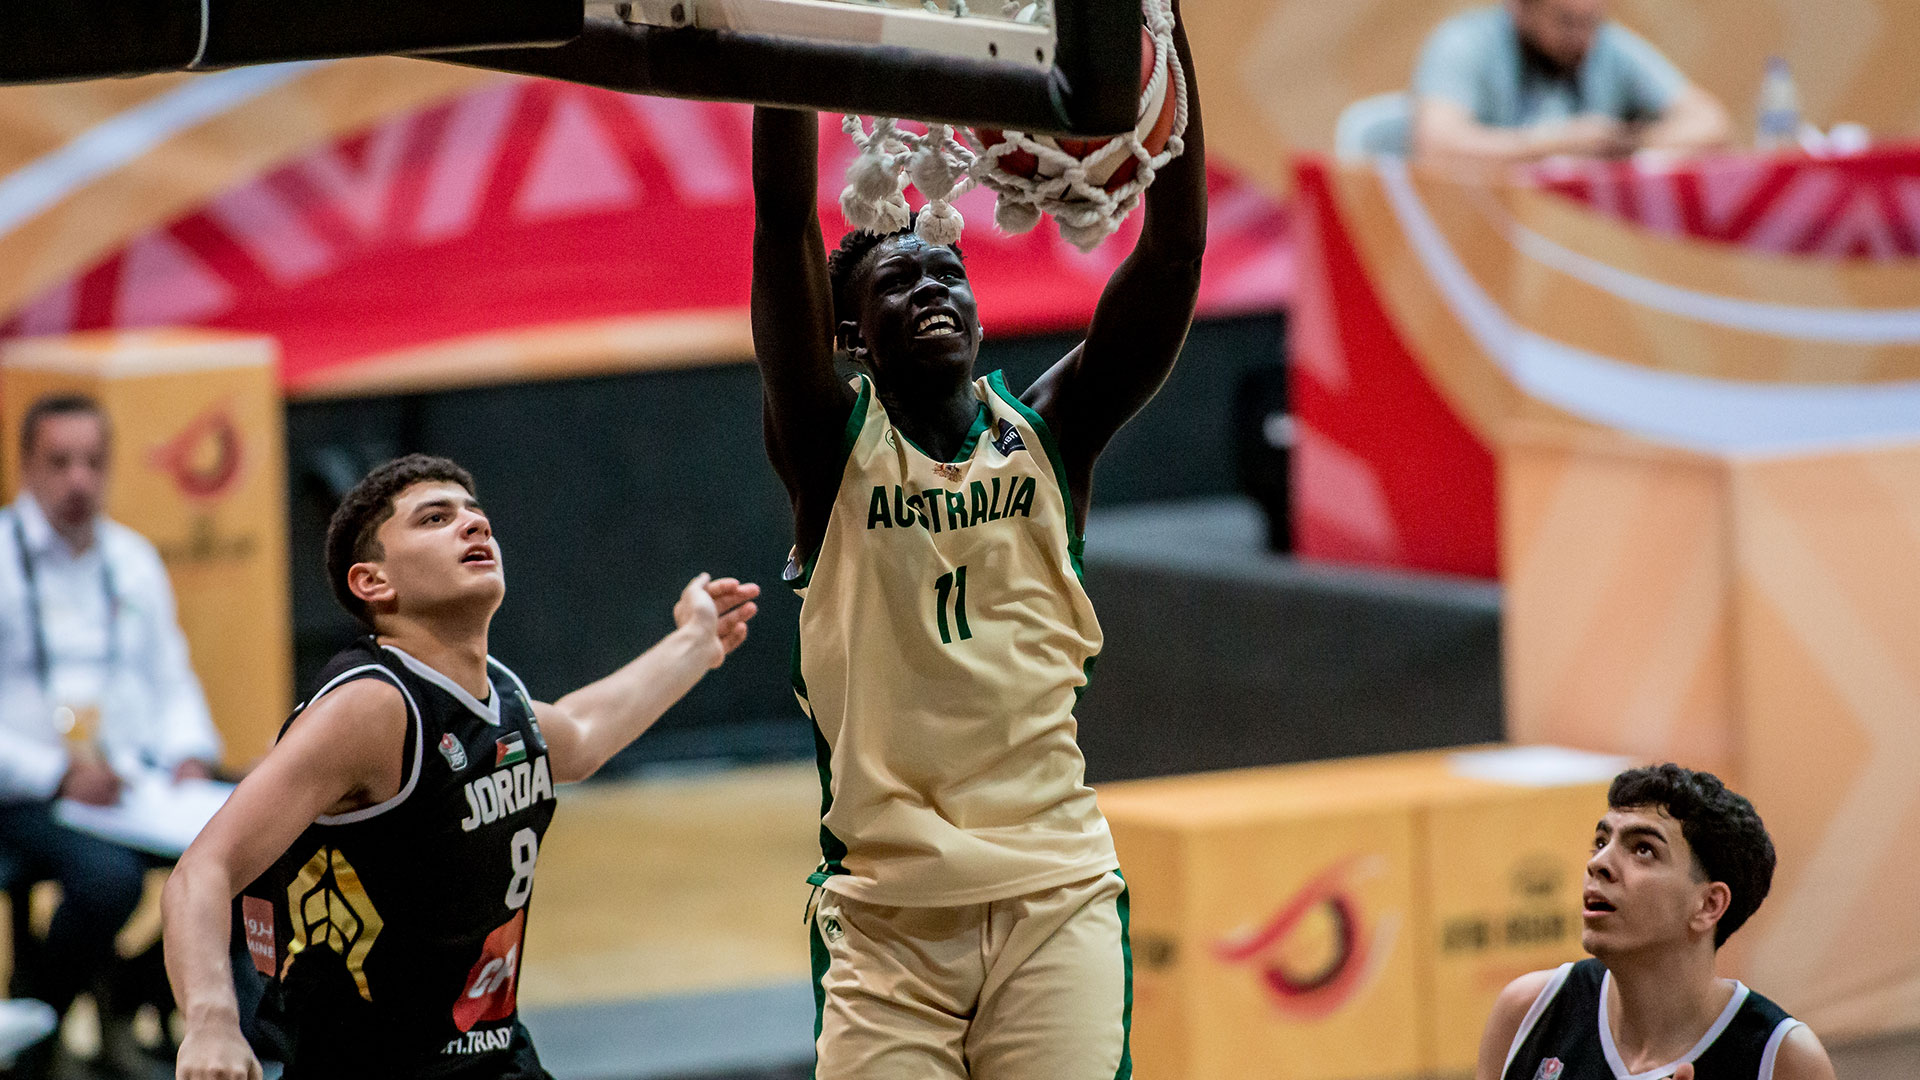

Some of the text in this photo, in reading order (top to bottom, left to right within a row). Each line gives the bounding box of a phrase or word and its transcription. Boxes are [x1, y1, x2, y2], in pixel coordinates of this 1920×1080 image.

[867, 476, 1037, 533] AUSTRALIA
[934, 565, 972, 644] 11
[461, 755, 556, 832] JORDA
[504, 827, 538, 910] 8
